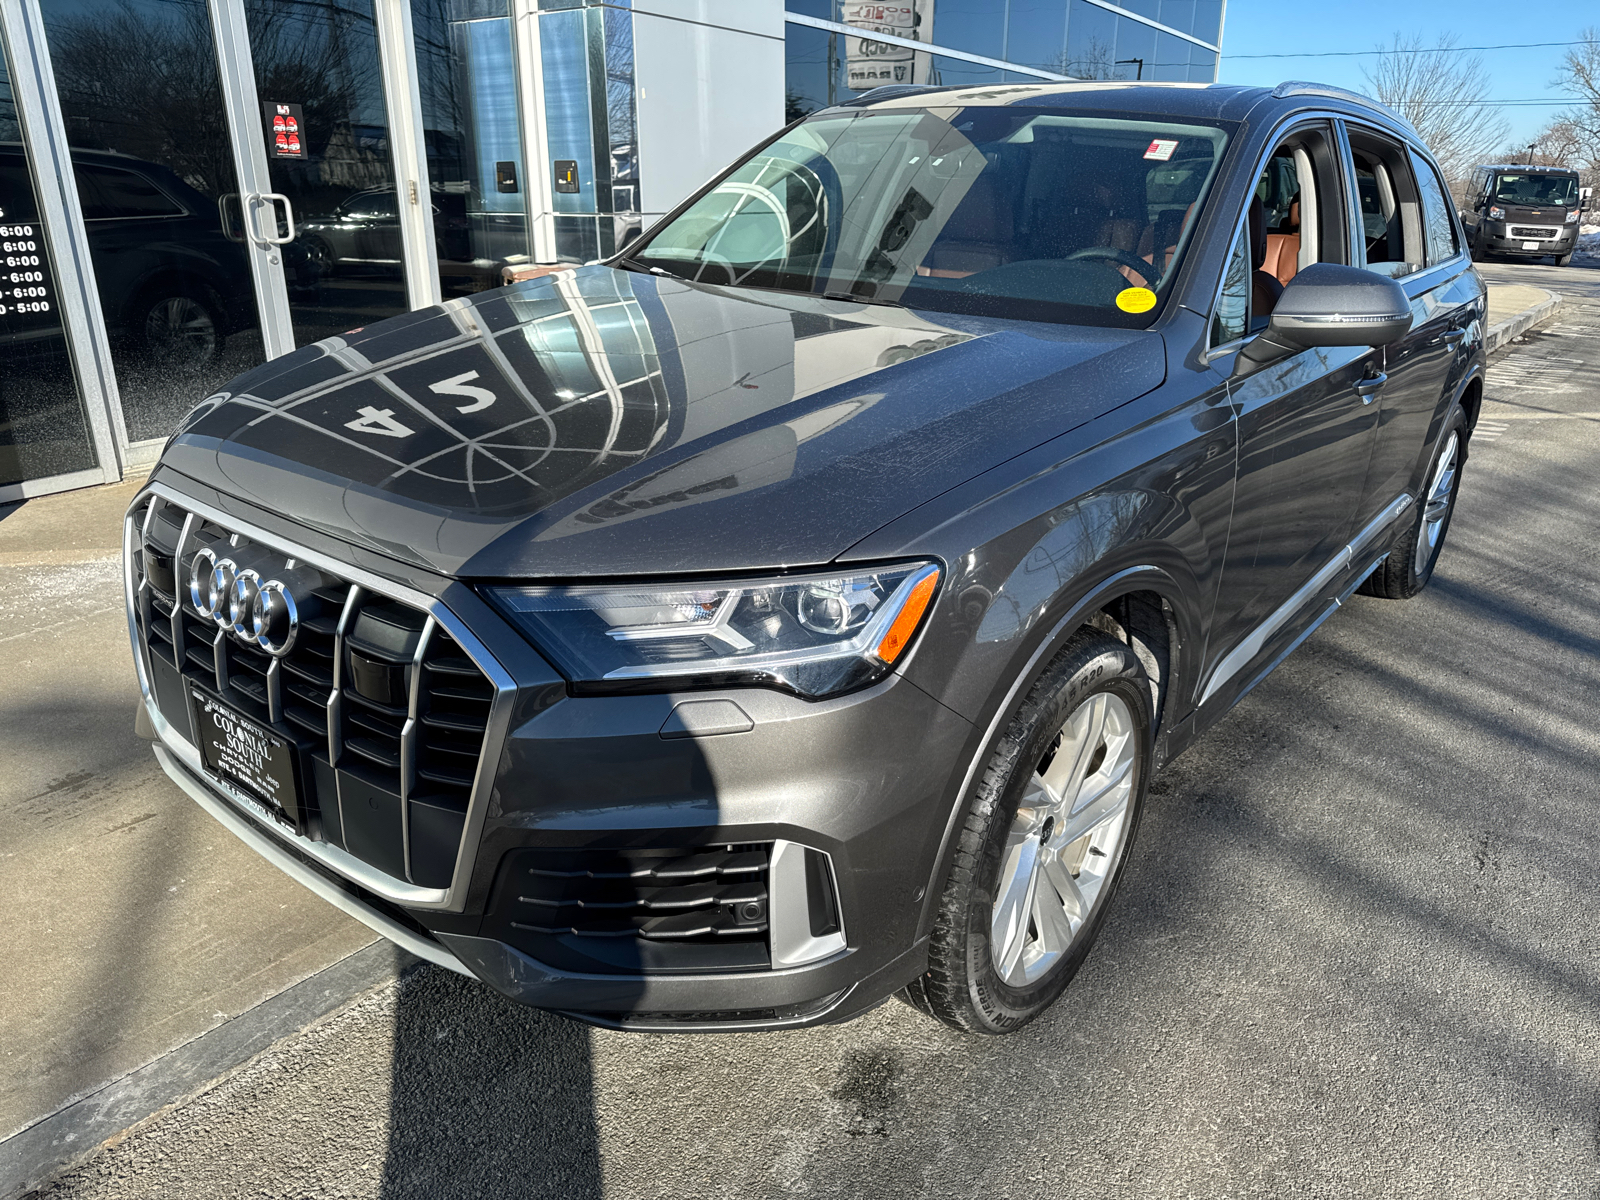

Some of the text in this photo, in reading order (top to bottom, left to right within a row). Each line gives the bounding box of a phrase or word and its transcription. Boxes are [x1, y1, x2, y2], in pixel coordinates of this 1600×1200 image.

[0, 226, 33, 237] 6:00
[3, 241, 36, 252] 6:00
[6, 256, 39, 267] 6:00
[10, 271, 43, 283] 6:00
[13, 286, 46, 298] 6:00
[17, 301, 49, 313] 5:00
[1080, 665, 1103, 690] R20
[213, 712, 272, 761] COLONIAL
[213, 740, 261, 775] CHRYSLER
[226, 733, 264, 770] SOUTH
[221, 752, 252, 777] DODGE
[975, 979, 995, 1018] VERDE
